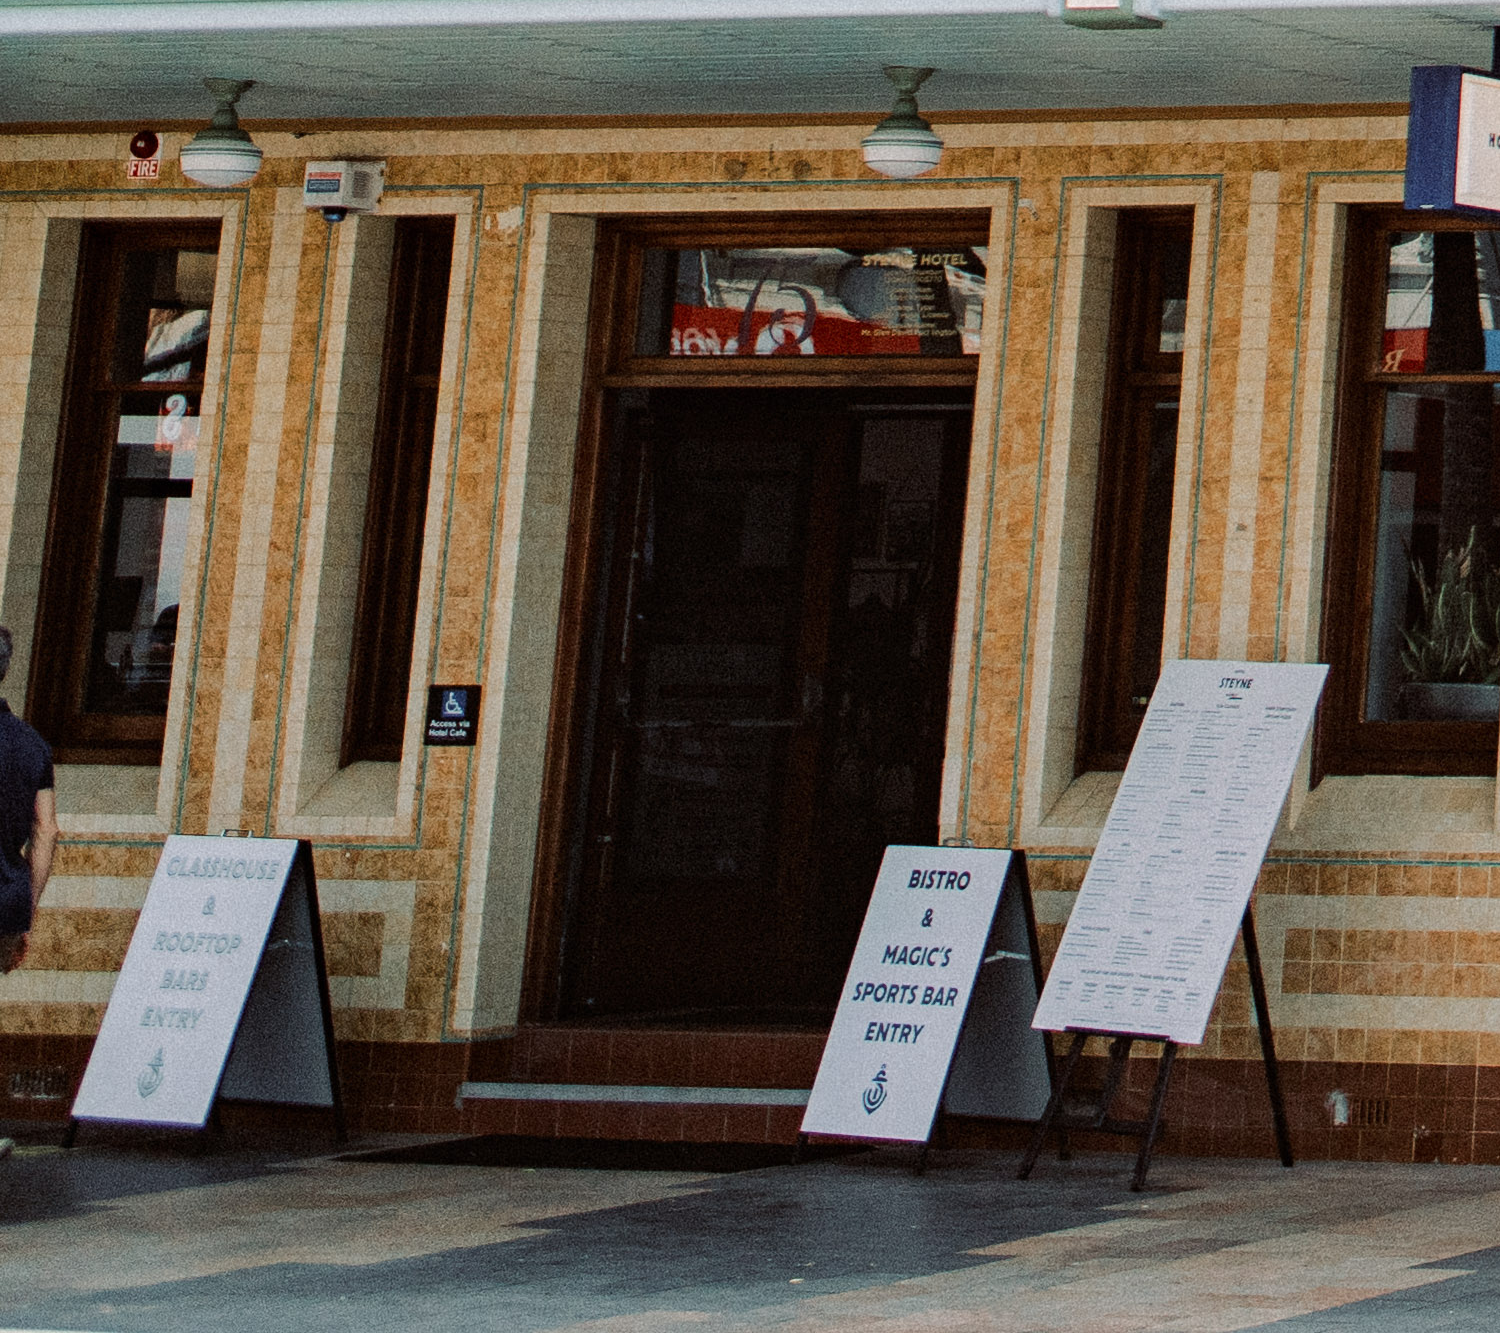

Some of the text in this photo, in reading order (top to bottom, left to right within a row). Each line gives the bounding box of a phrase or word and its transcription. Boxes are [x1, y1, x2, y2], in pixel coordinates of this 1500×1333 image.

[129, 160, 157, 177] FIRE
[920, 253, 968, 266] HOTEL
[1219, 677, 1253, 689] STEYNE
[429, 728, 449, 737] Hotel
[430, 719, 457, 728] Access
[166, 855, 281, 881] GLASSHOUSE
[907, 869, 972, 890] BISTRO
[202, 896, 216, 915] &
[921, 908, 934, 928] &
[152, 932, 241, 954] ROOFTOP
[881, 945, 952, 967] MAGIC'S
[159, 969, 209, 991] BARS
[852, 982, 959, 1007] SPORTS BAR
[139, 1007, 204, 1029] ENTRY
[863, 1022, 924, 1044] ENTRY
